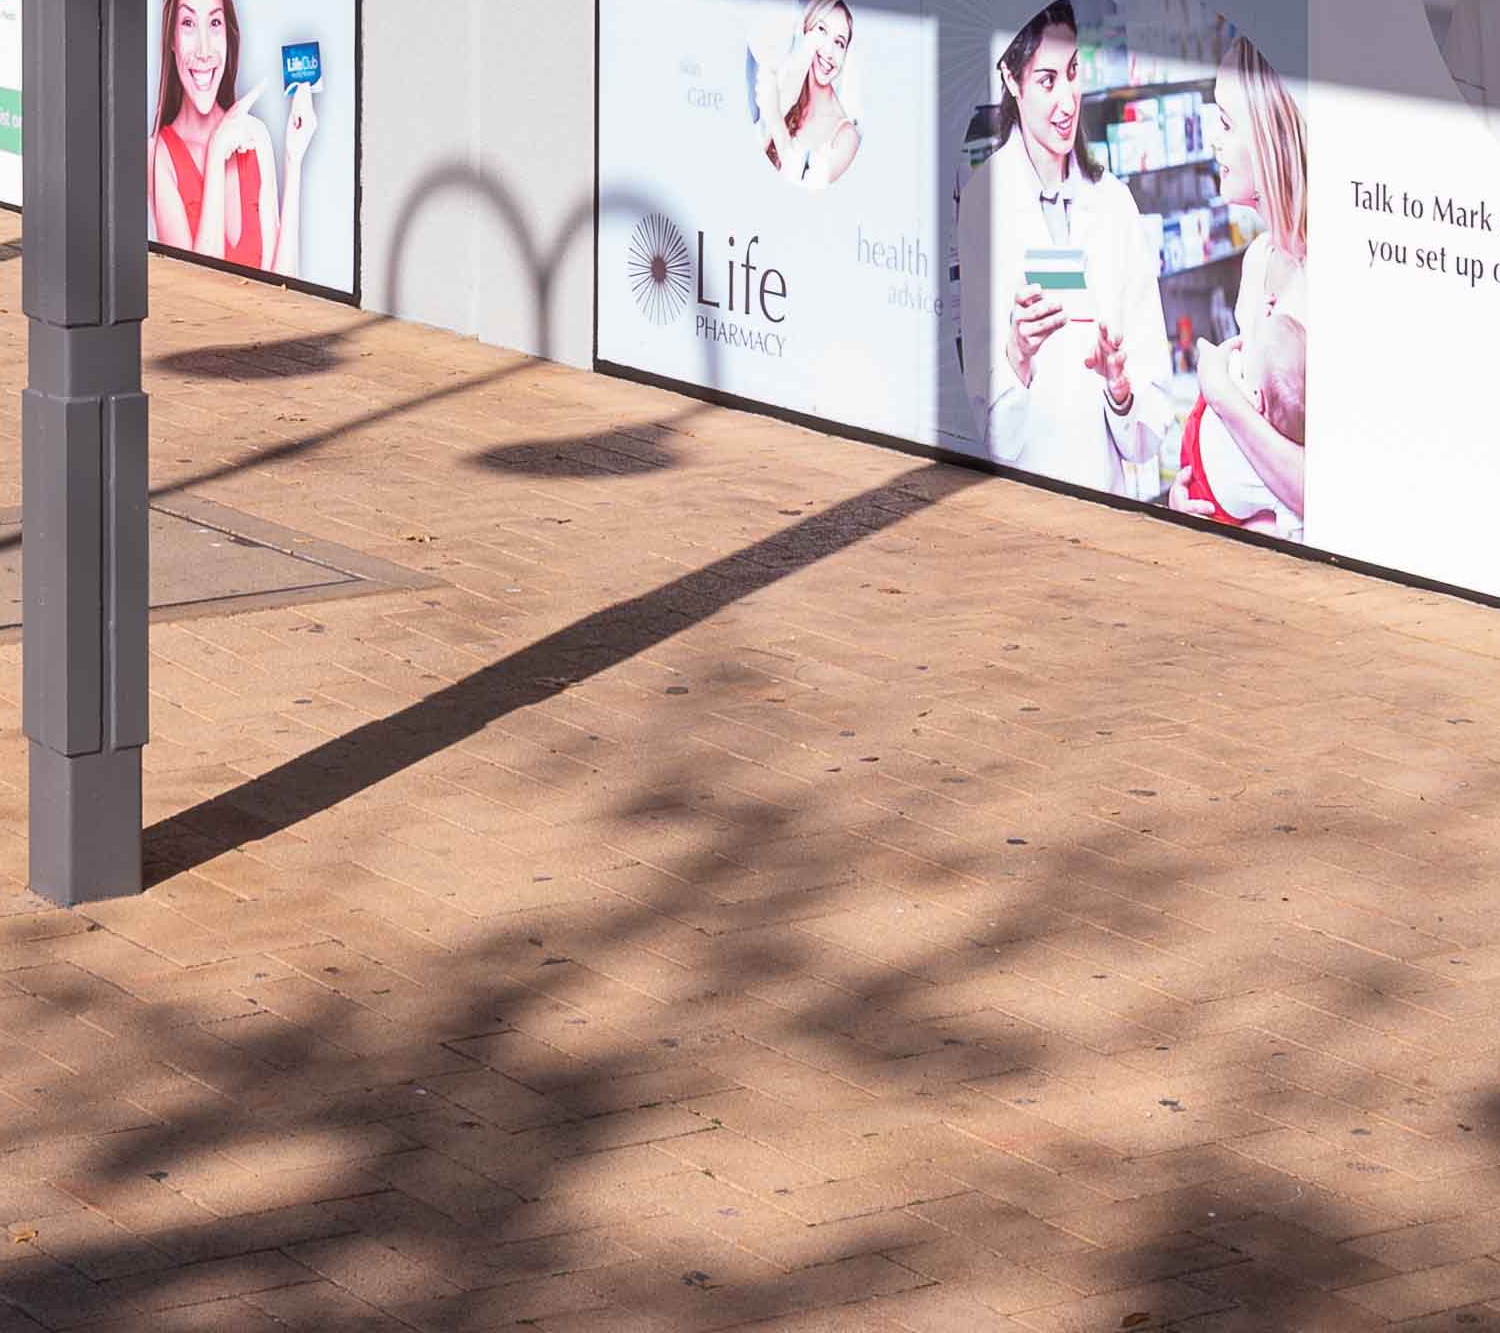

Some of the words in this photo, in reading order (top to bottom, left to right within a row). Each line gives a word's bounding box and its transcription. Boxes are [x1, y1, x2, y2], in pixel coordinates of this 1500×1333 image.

[687, 85, 724, 109] care
[1351, 181, 1394, 214] Talk
[1401, 190, 1425, 220] to
[1432, 194, 1493, 233] Mark
[856, 225, 929, 276] health
[1367, 235, 1408, 269] you
[1415, 241, 1448, 274] set
[1455, 250, 1485, 286] up
[697, 229, 788, 324] Life
[887, 281, 945, 317] advice
[695, 314, 787, 359] PHARMACY
